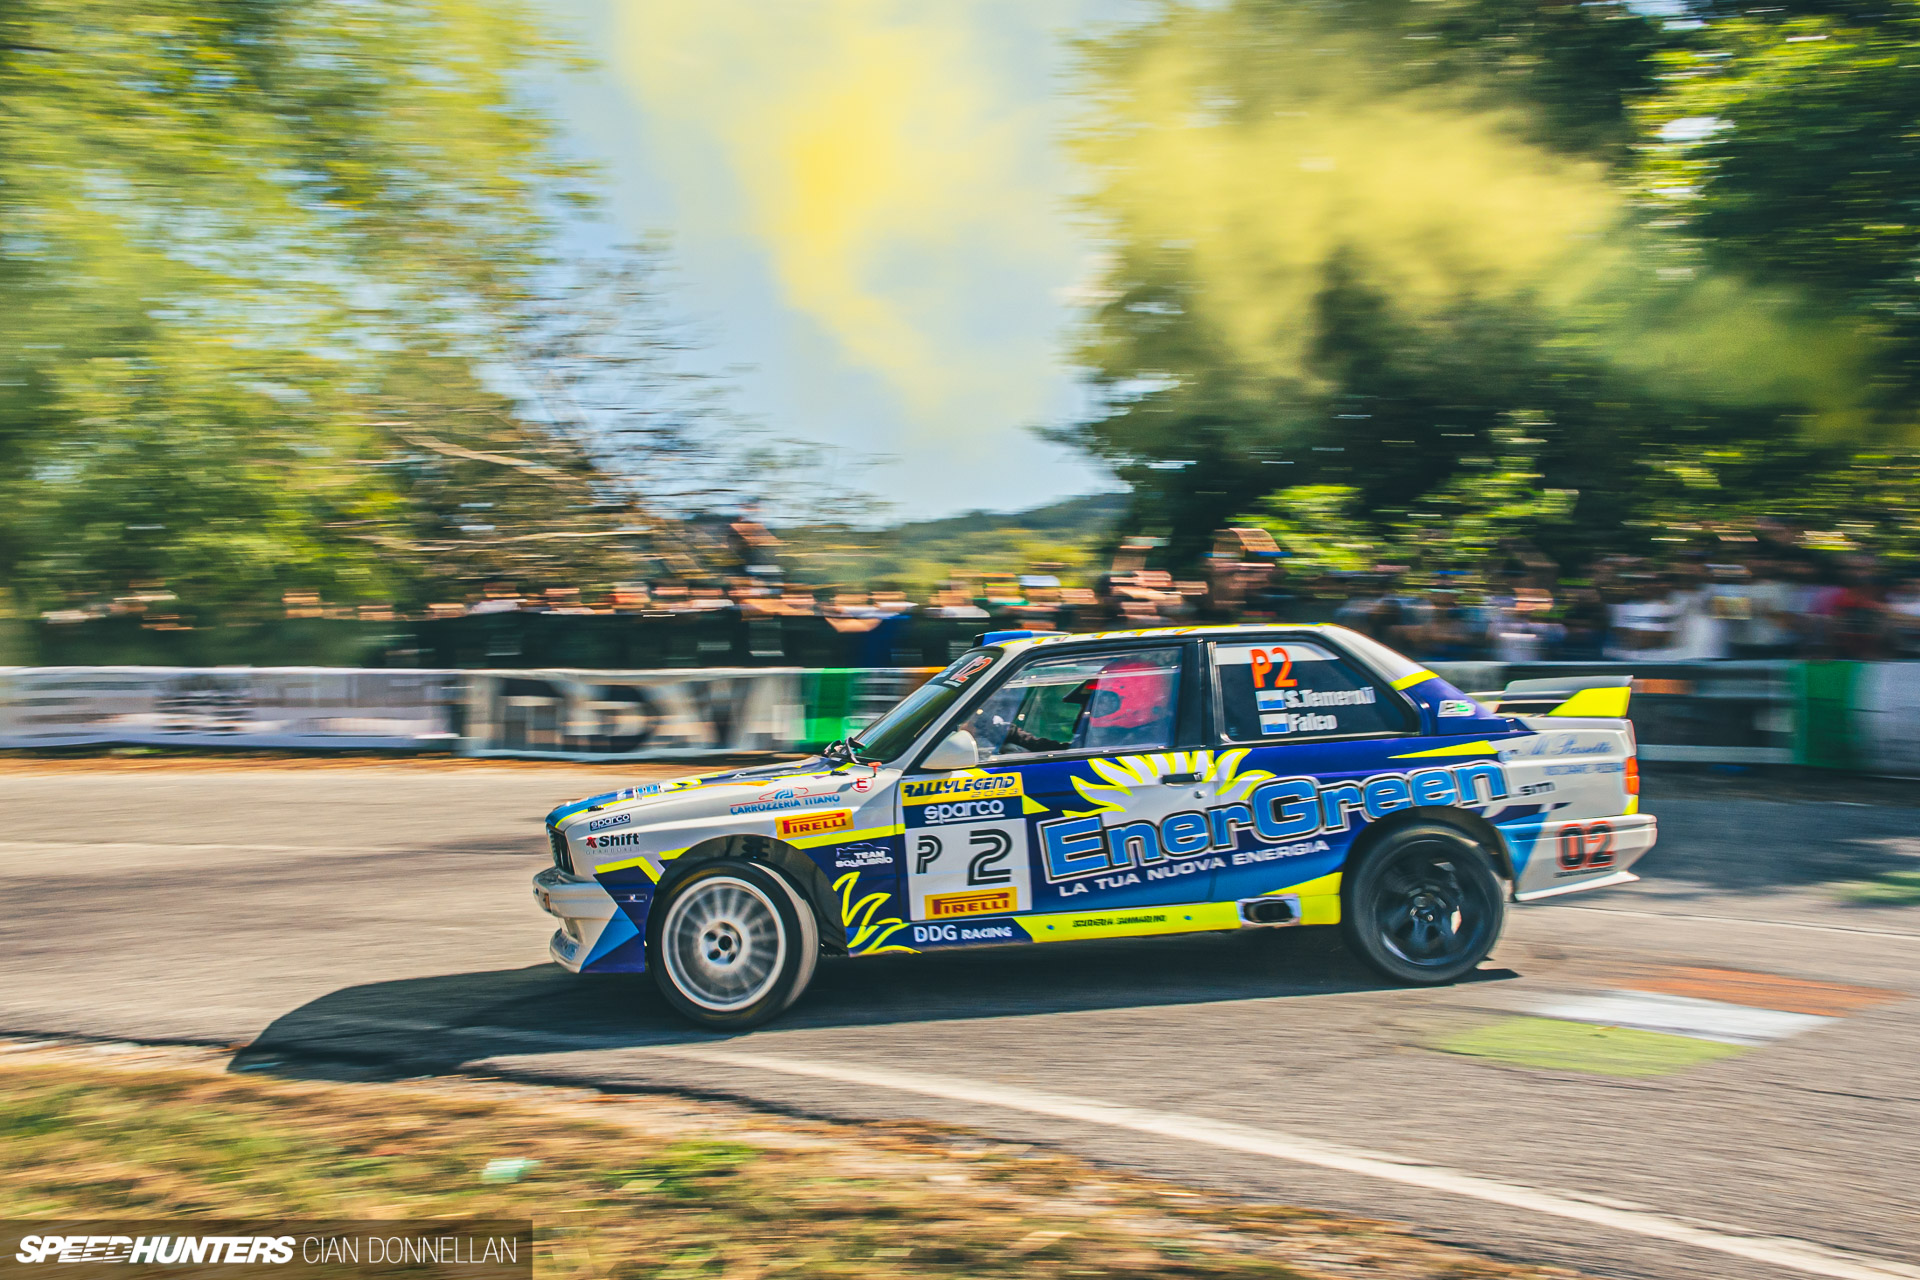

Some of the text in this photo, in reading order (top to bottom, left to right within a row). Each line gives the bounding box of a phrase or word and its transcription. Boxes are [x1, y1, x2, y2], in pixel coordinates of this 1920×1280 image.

[1250, 647, 1298, 689] P2
[904, 776, 1015, 797] RALLYLEGEND
[729, 794, 841, 816] CARROZZERIA TITANO
[923, 799, 1005, 824] sparco
[591, 814, 630, 829] sparco
[782, 812, 847, 835] PIRELLI
[1036, 759, 1508, 884] EnerGreen
[966, 828, 1013, 886] 2
[1555, 821, 1618, 870] 02
[1058, 839, 1331, 897] LA TUA NUOVA ENERGIA
[931, 892, 1010, 915] PIRELLI
[913, 924, 1013, 942] DDG RACING
